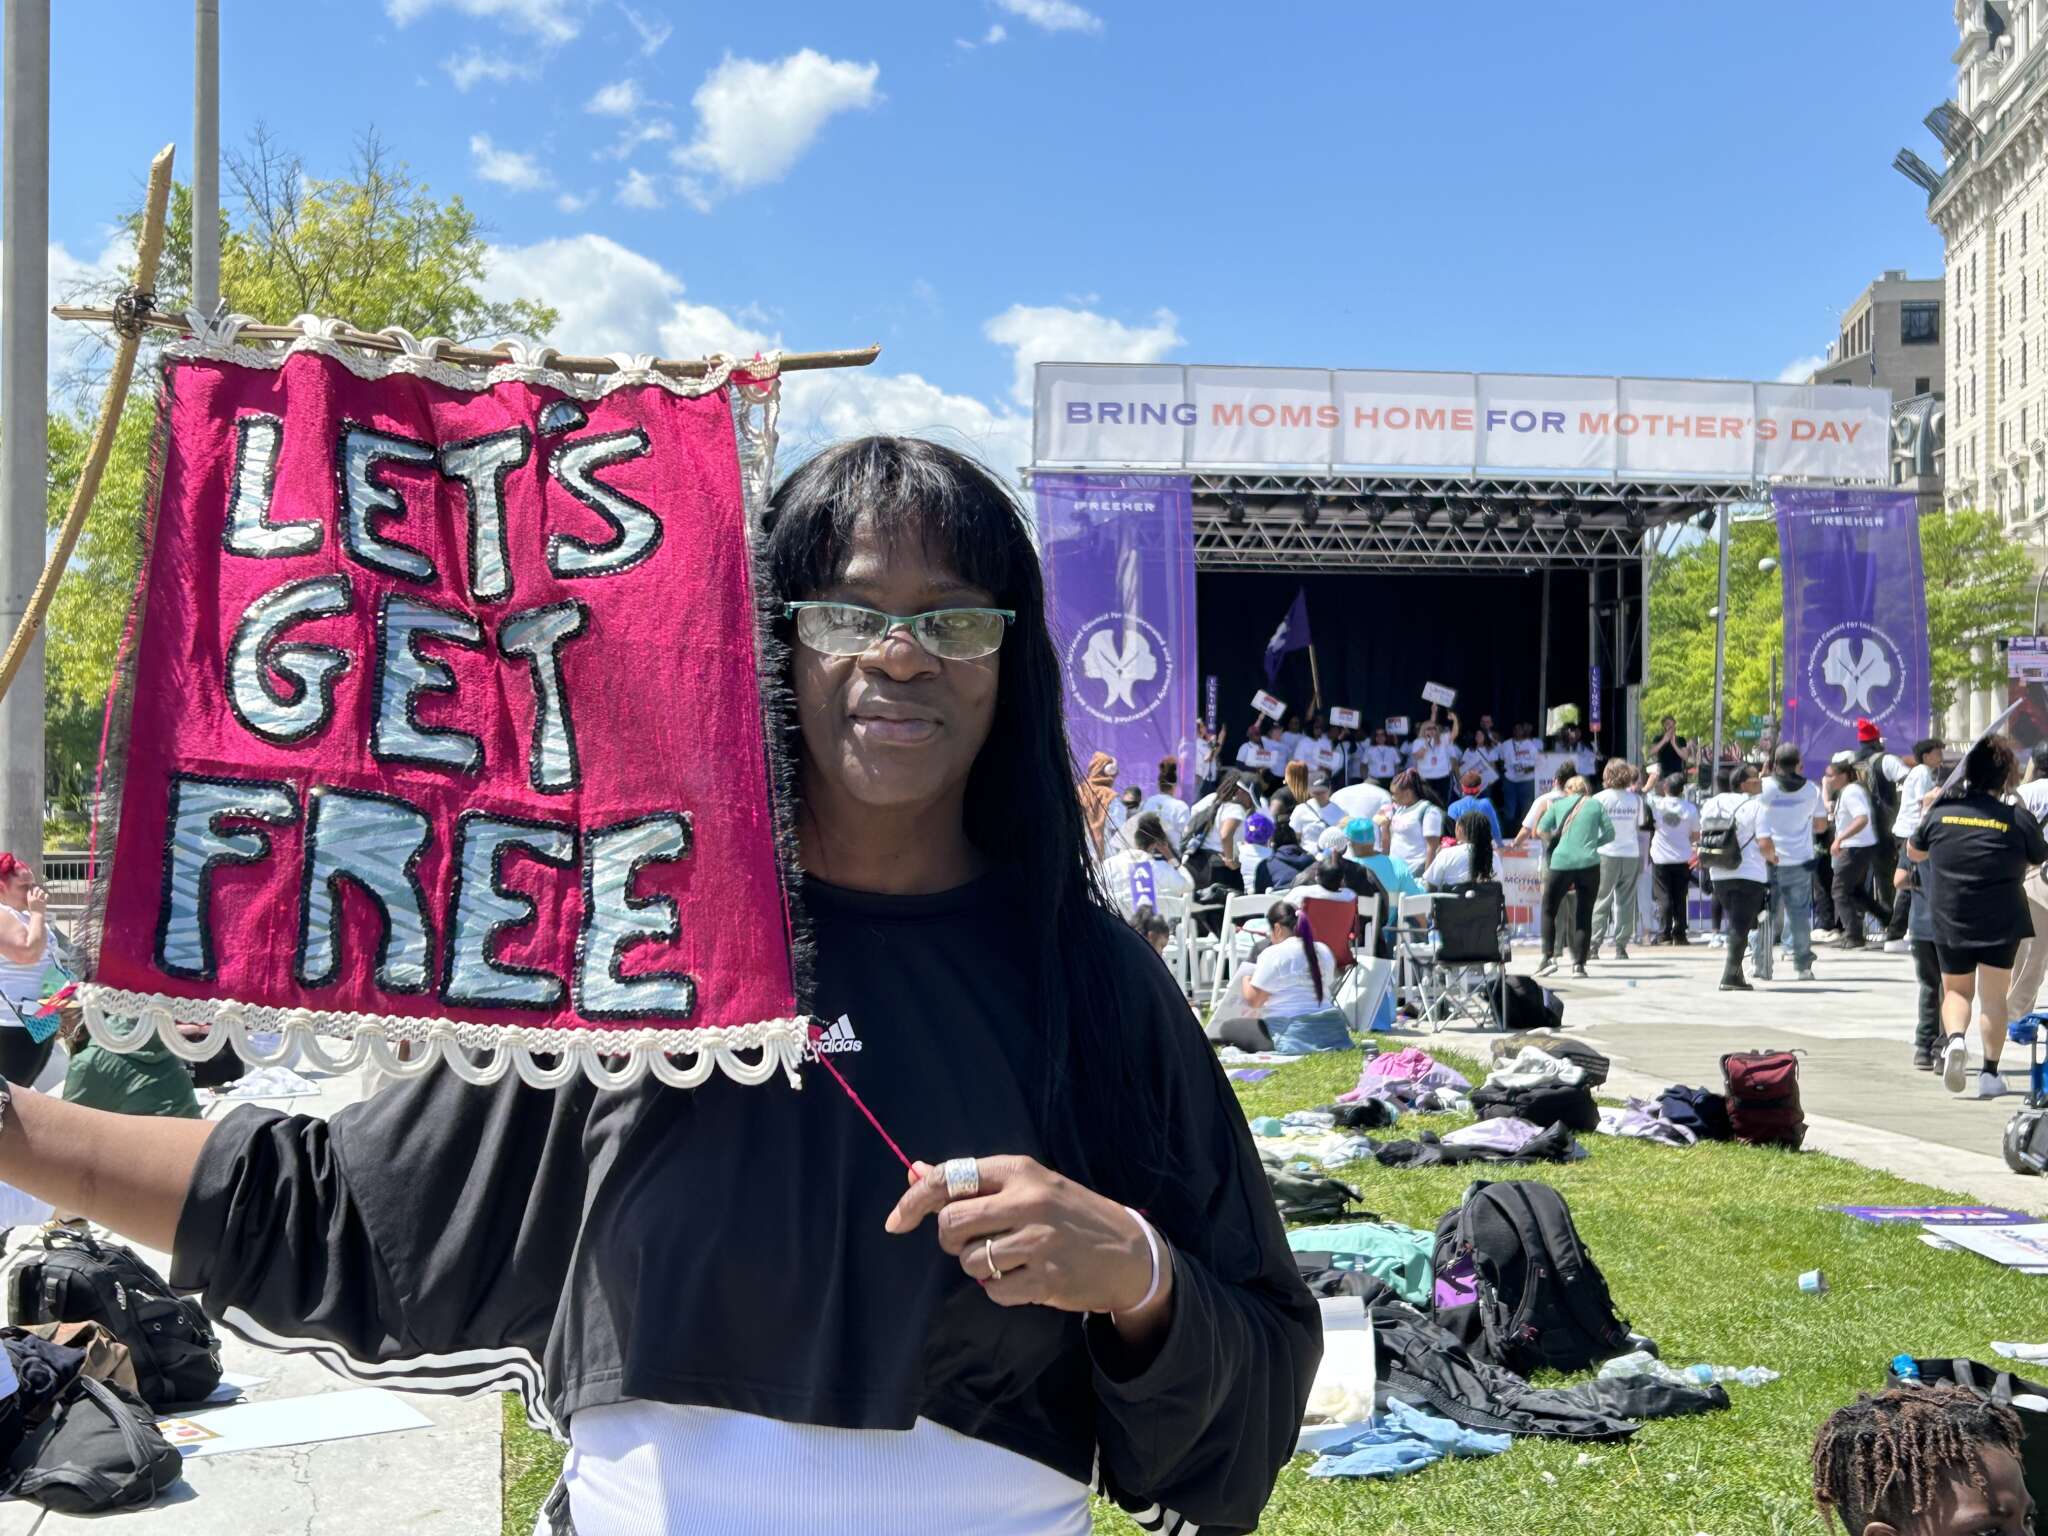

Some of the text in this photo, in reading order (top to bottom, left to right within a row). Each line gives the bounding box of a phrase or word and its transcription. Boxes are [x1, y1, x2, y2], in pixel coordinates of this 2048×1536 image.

[223, 401, 664, 601] LET'S
[1066, 402, 1861, 443] BRING MOMS HOME FOR MOTHER'S DAY
[224, 574, 590, 795] GET
[153, 772, 695, 1020] FREE
